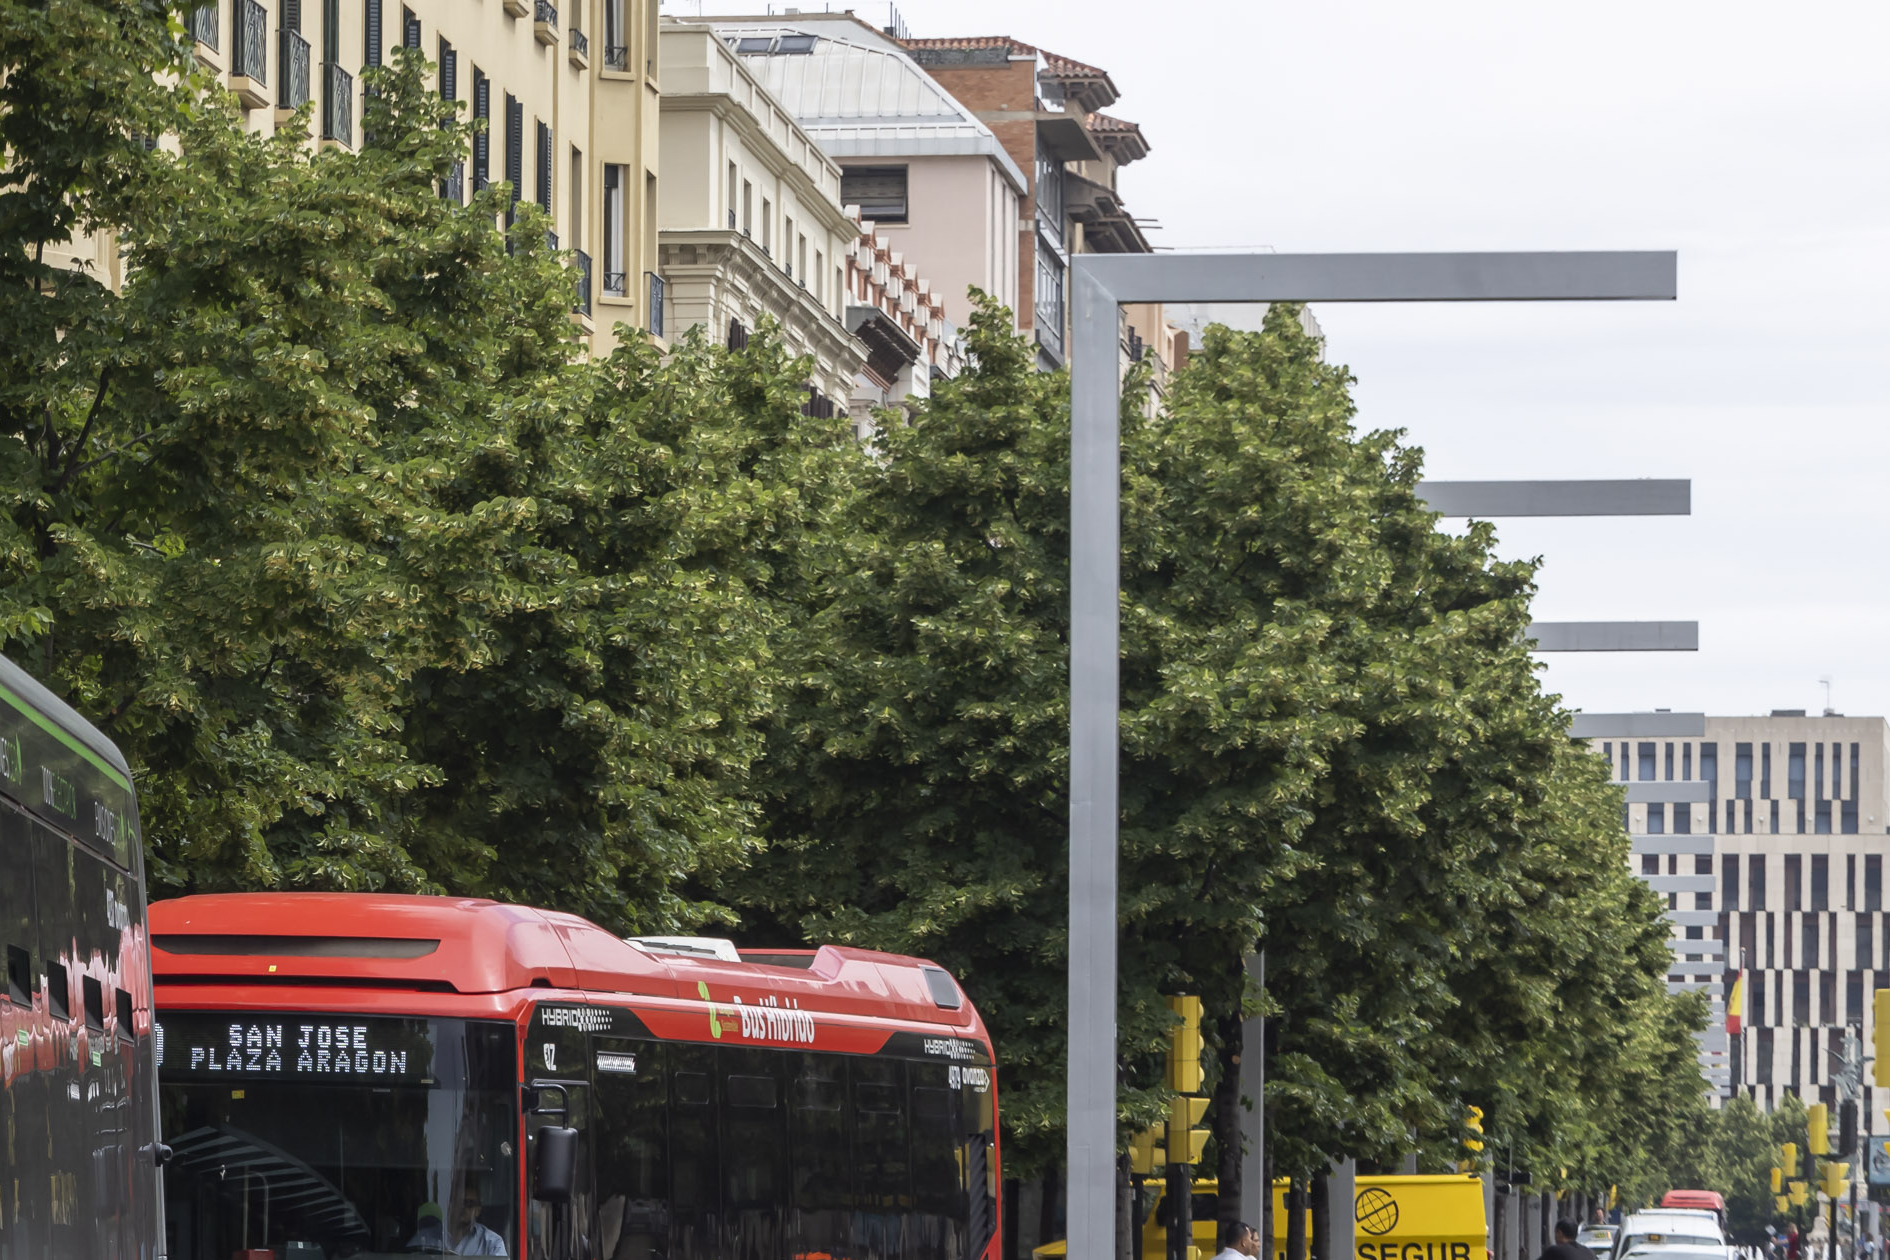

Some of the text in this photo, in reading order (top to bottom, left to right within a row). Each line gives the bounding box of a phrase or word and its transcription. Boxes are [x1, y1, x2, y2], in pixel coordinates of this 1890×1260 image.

[541, 1008, 579, 1027] HYBRID
[229, 1024, 368, 1049] SAN JOSE
[924, 1039, 951, 1056] HYBRID
[191, 1048, 408, 1074] PLAZA ARAGON
